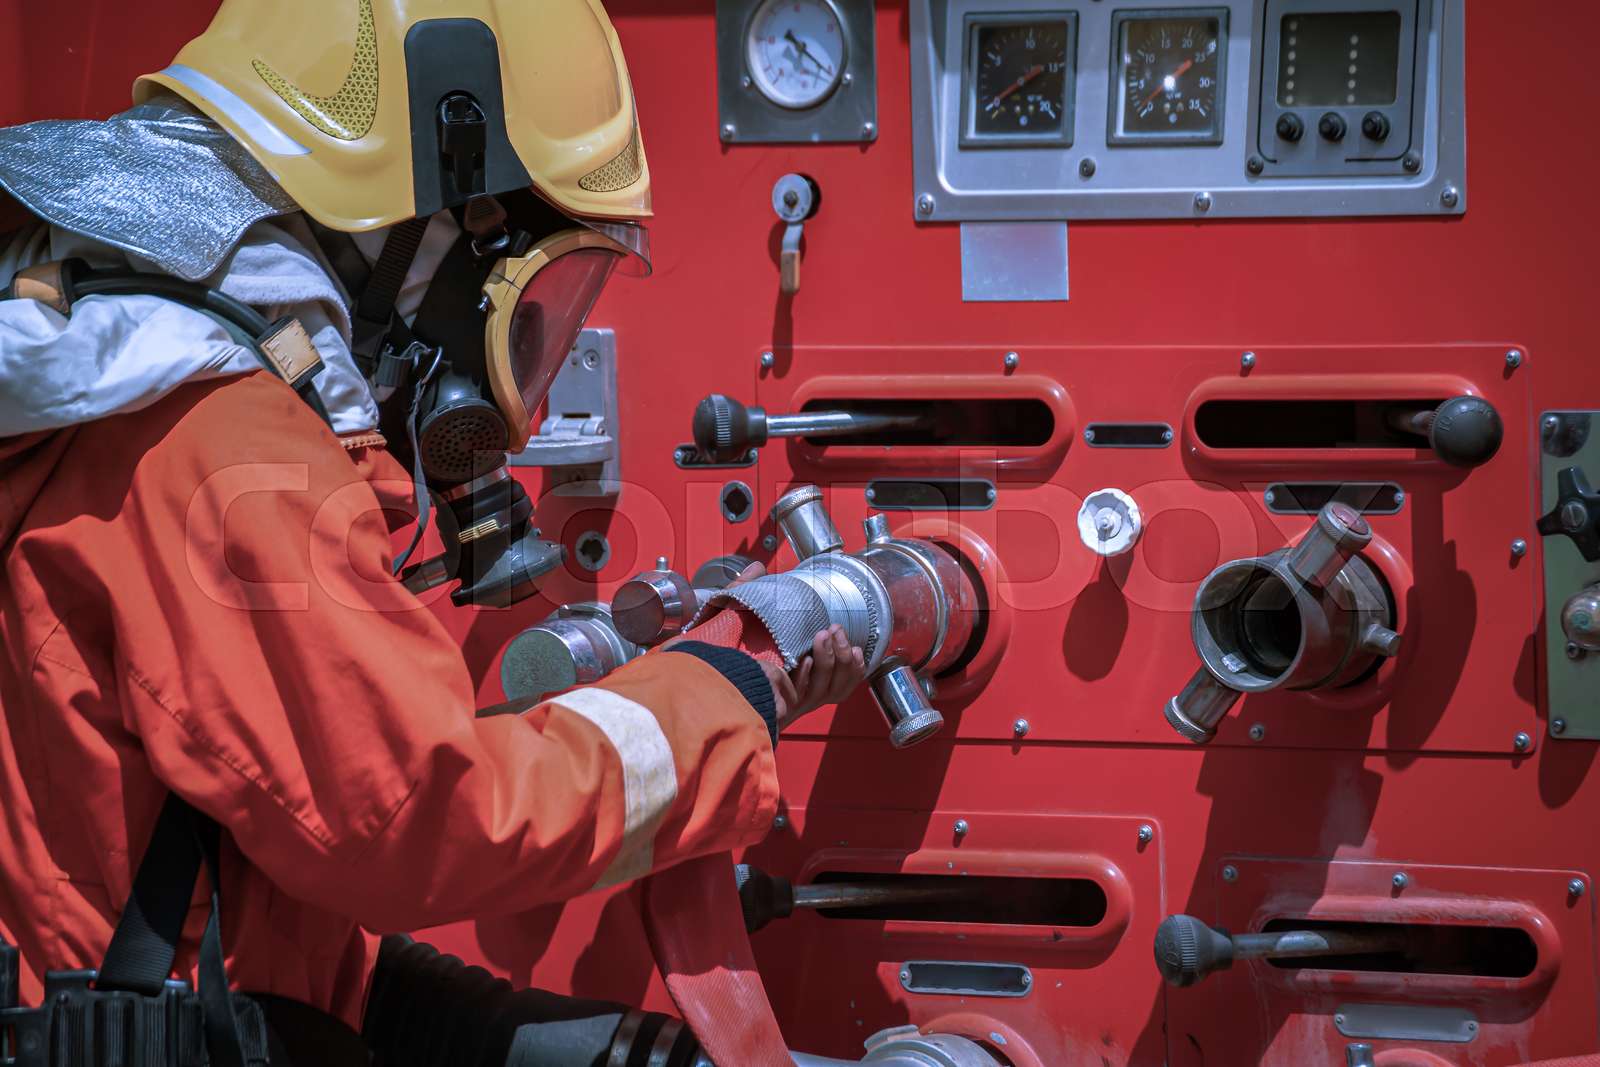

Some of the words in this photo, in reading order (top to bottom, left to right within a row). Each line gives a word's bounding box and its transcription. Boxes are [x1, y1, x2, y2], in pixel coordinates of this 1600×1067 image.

[1025, 39, 1036, 49] 10
[1182, 39, 1193, 48] 20
[1145, 54, 1155, 64] 10
[1138, 79, 1144, 89] 5
[1199, 78, 1210, 88] 30
[1040, 101, 1051, 112] 20
[1147, 102, 1153, 112] 0
[1188, 99, 1200, 109] 35
